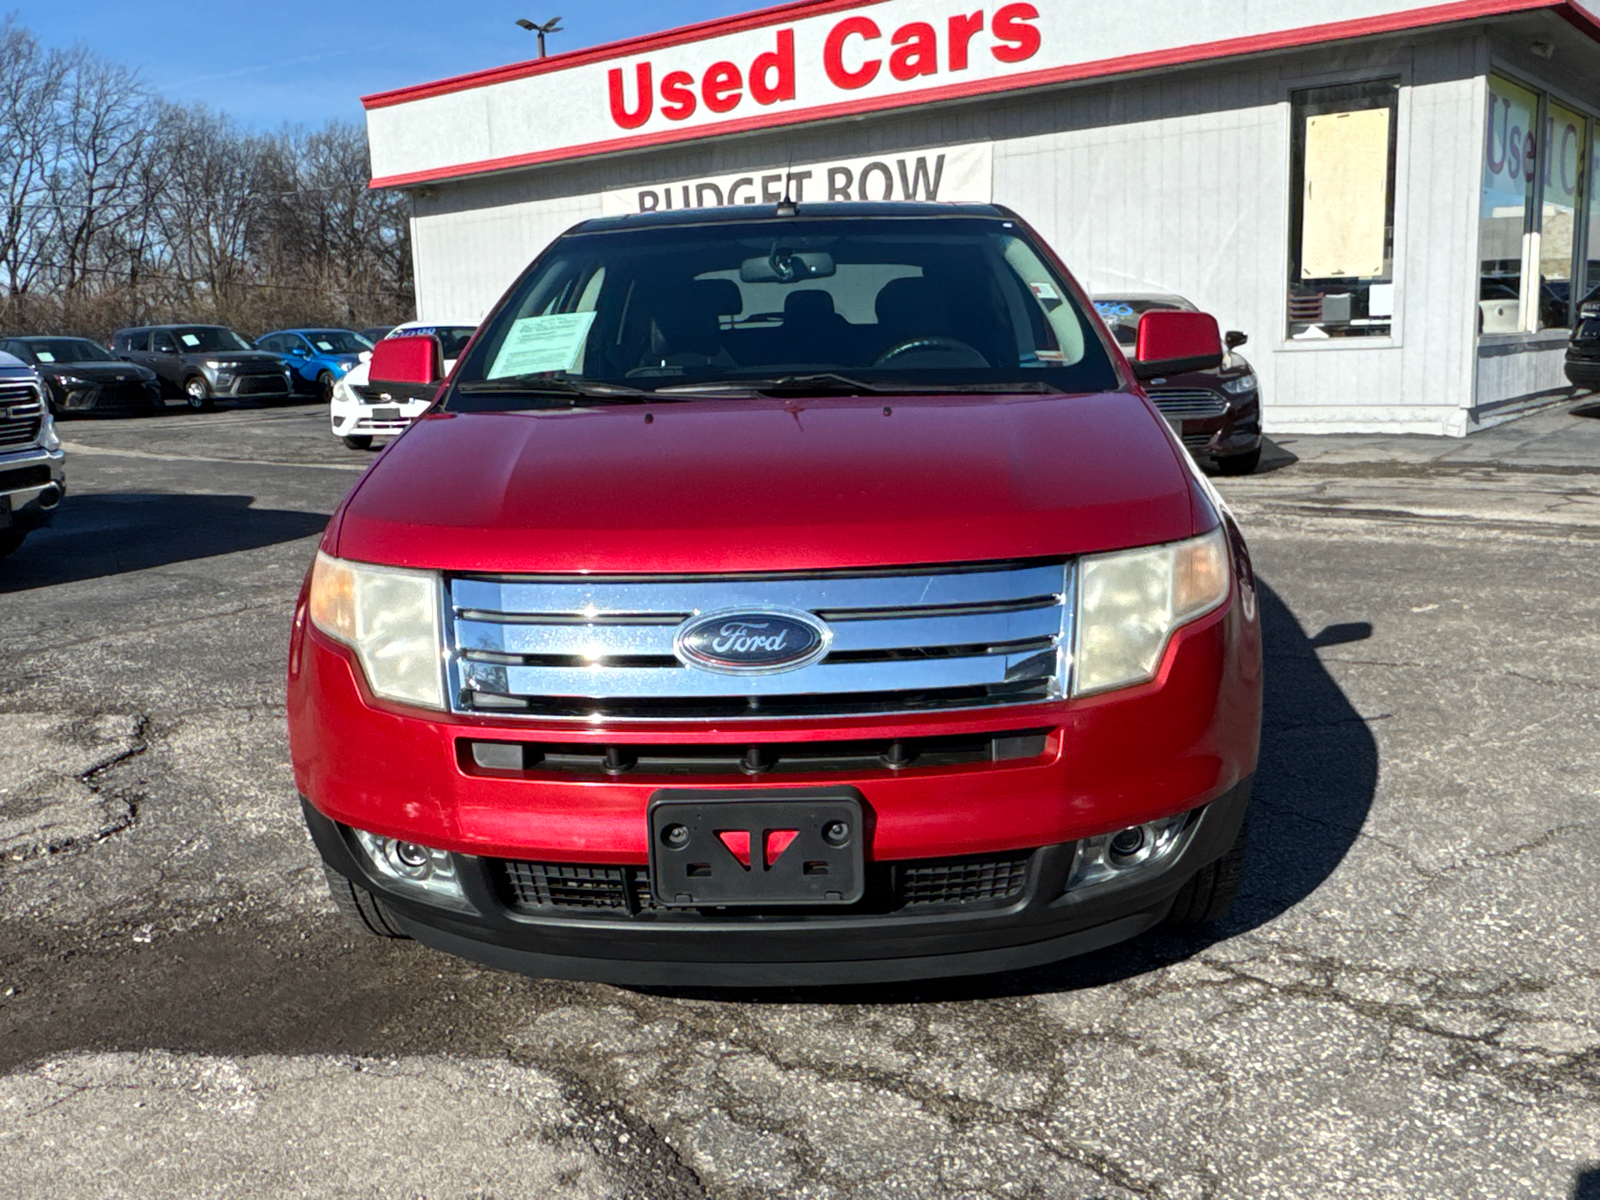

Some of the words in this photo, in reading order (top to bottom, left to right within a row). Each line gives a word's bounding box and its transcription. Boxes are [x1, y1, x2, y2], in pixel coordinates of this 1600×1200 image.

[608, 28, 796, 129] Used
[823, 2, 1042, 90] Cars
[827, 154, 946, 202] ROW
[712, 622, 789, 653] Ford
